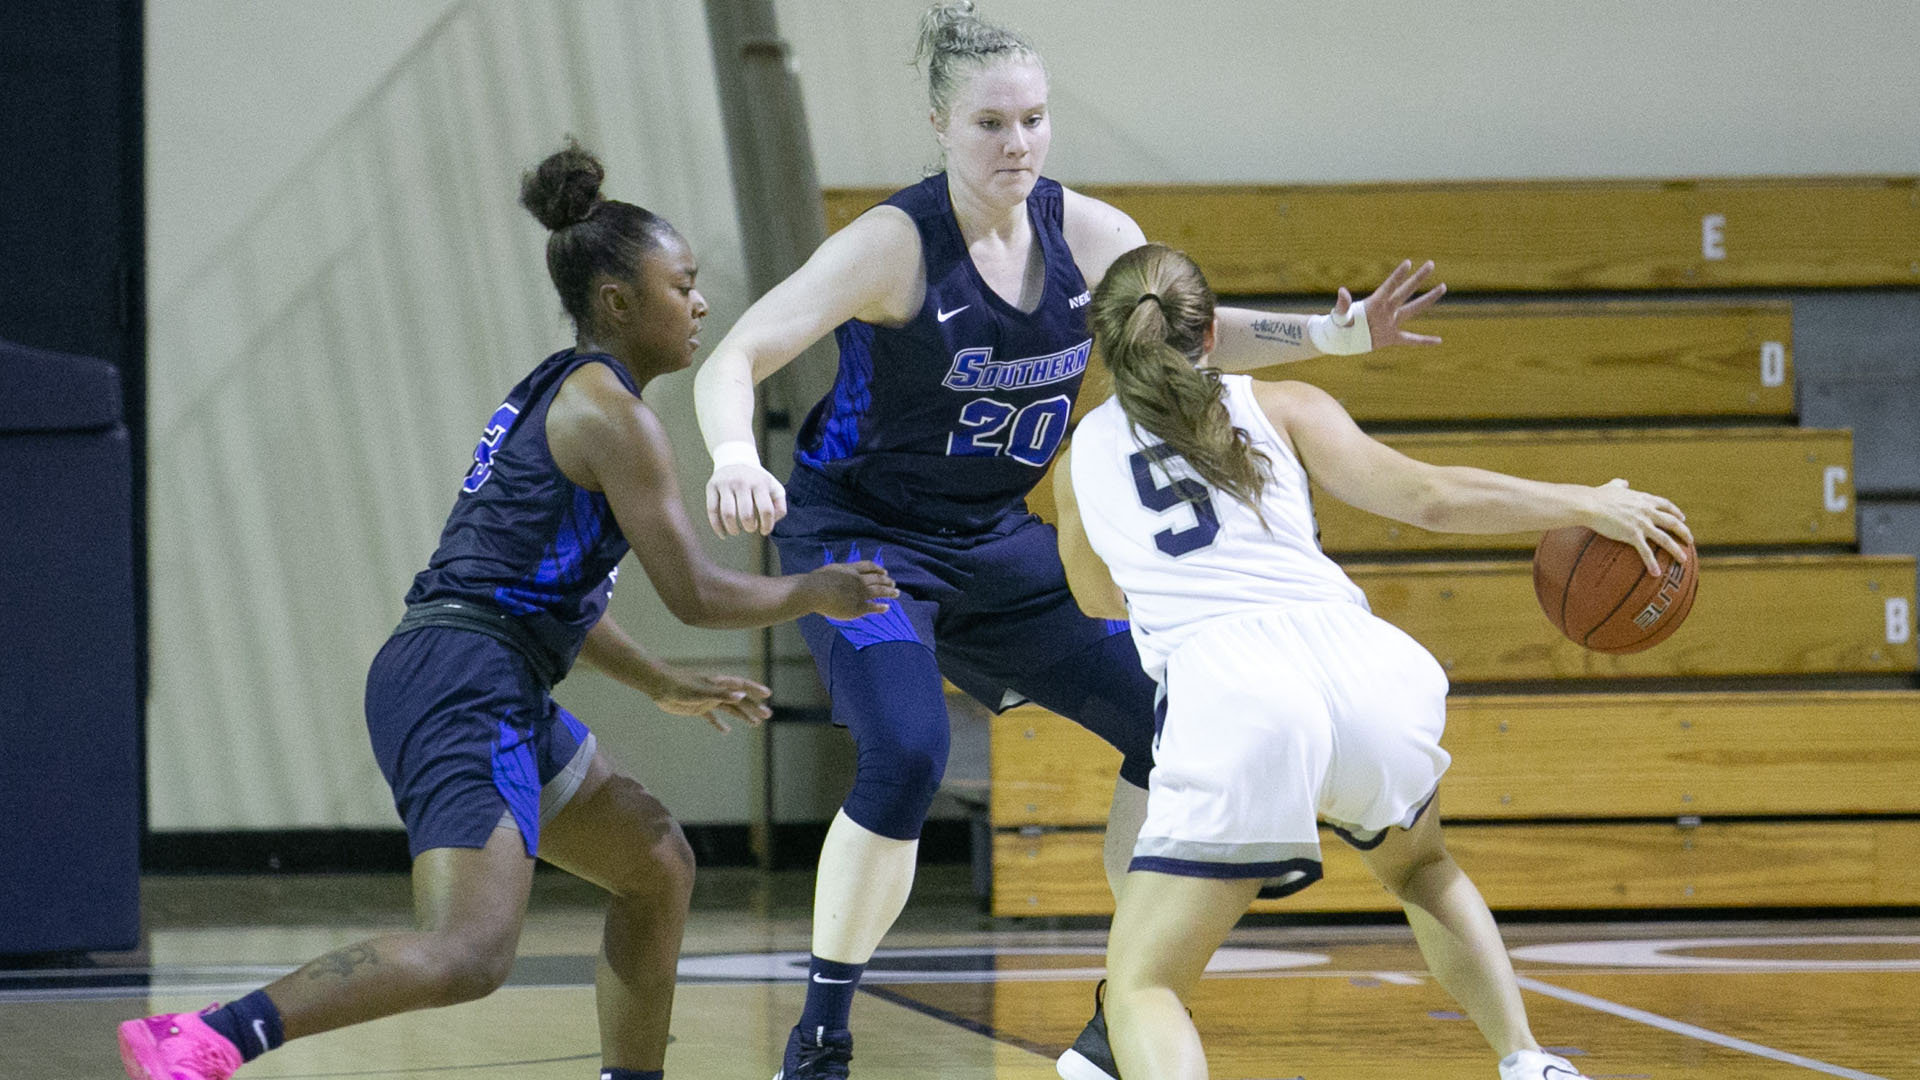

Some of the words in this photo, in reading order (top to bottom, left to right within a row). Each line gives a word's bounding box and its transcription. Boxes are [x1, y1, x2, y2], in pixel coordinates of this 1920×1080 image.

[1702, 214, 1727, 260] E
[942, 338, 1092, 391] SOUTHERN
[946, 394, 1071, 468] 20
[1127, 441, 1222, 560] 5
[1824, 466, 1848, 512] C
[1633, 560, 1687, 632] ELITE
[1885, 597, 1910, 644] B
